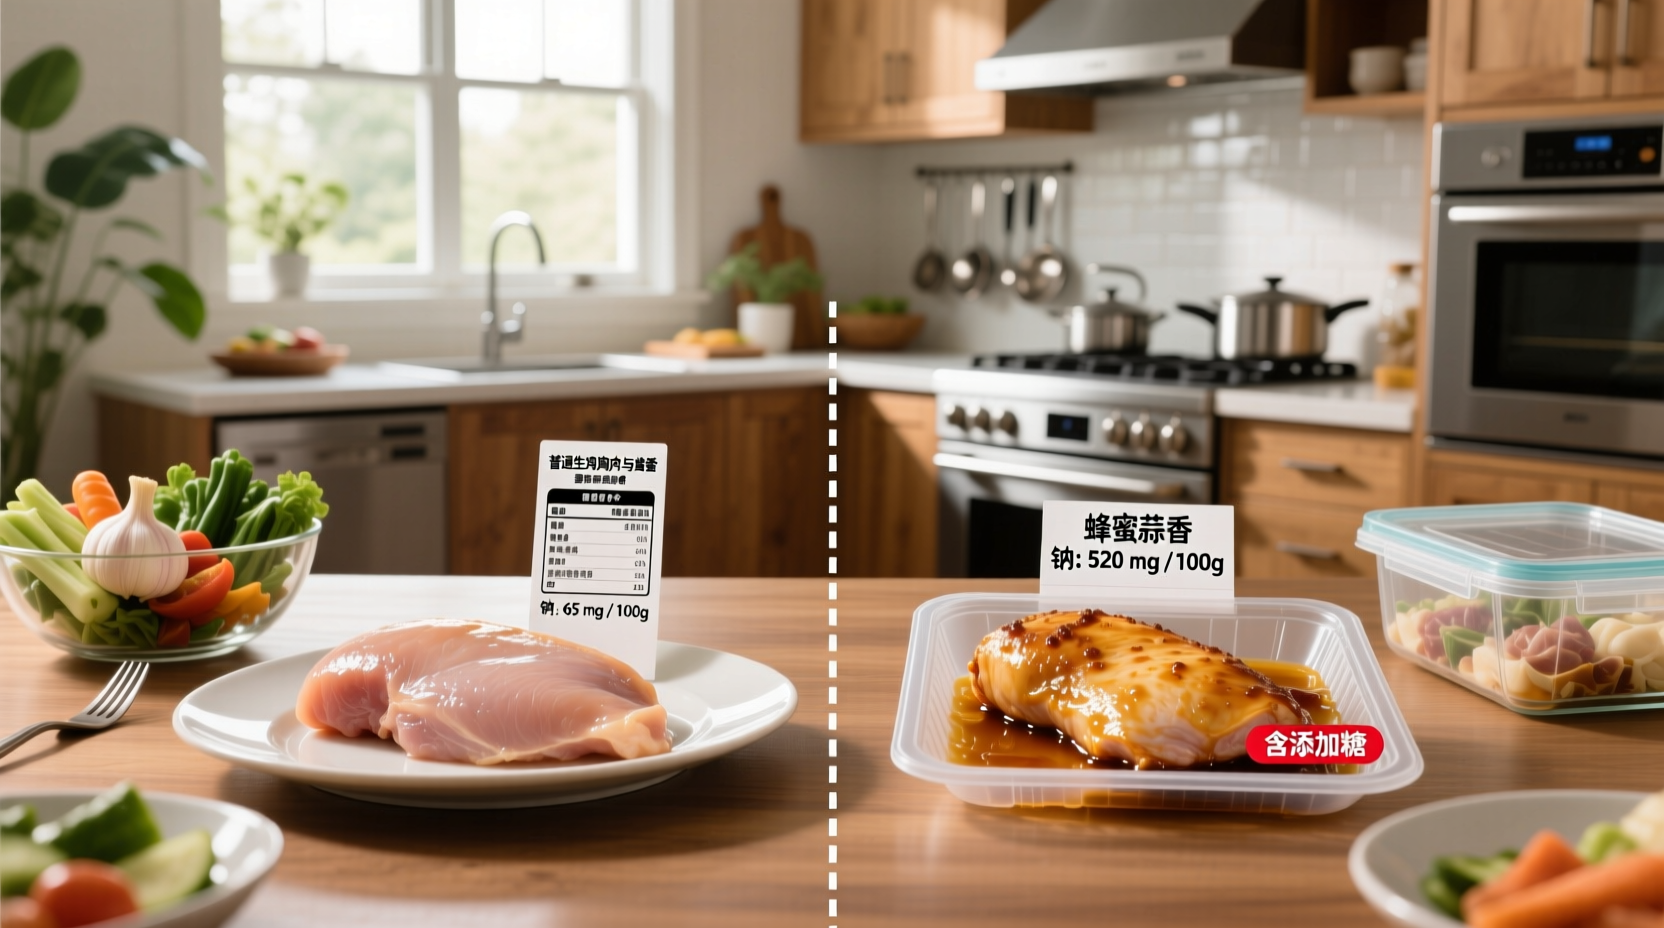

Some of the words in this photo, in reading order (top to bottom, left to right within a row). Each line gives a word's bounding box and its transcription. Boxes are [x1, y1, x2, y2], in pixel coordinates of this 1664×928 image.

[1084, 512, 1192, 544] 蜂蜜蒜香
[1088, 550, 1123, 569] 520
[562, 602, 580, 616] 65
